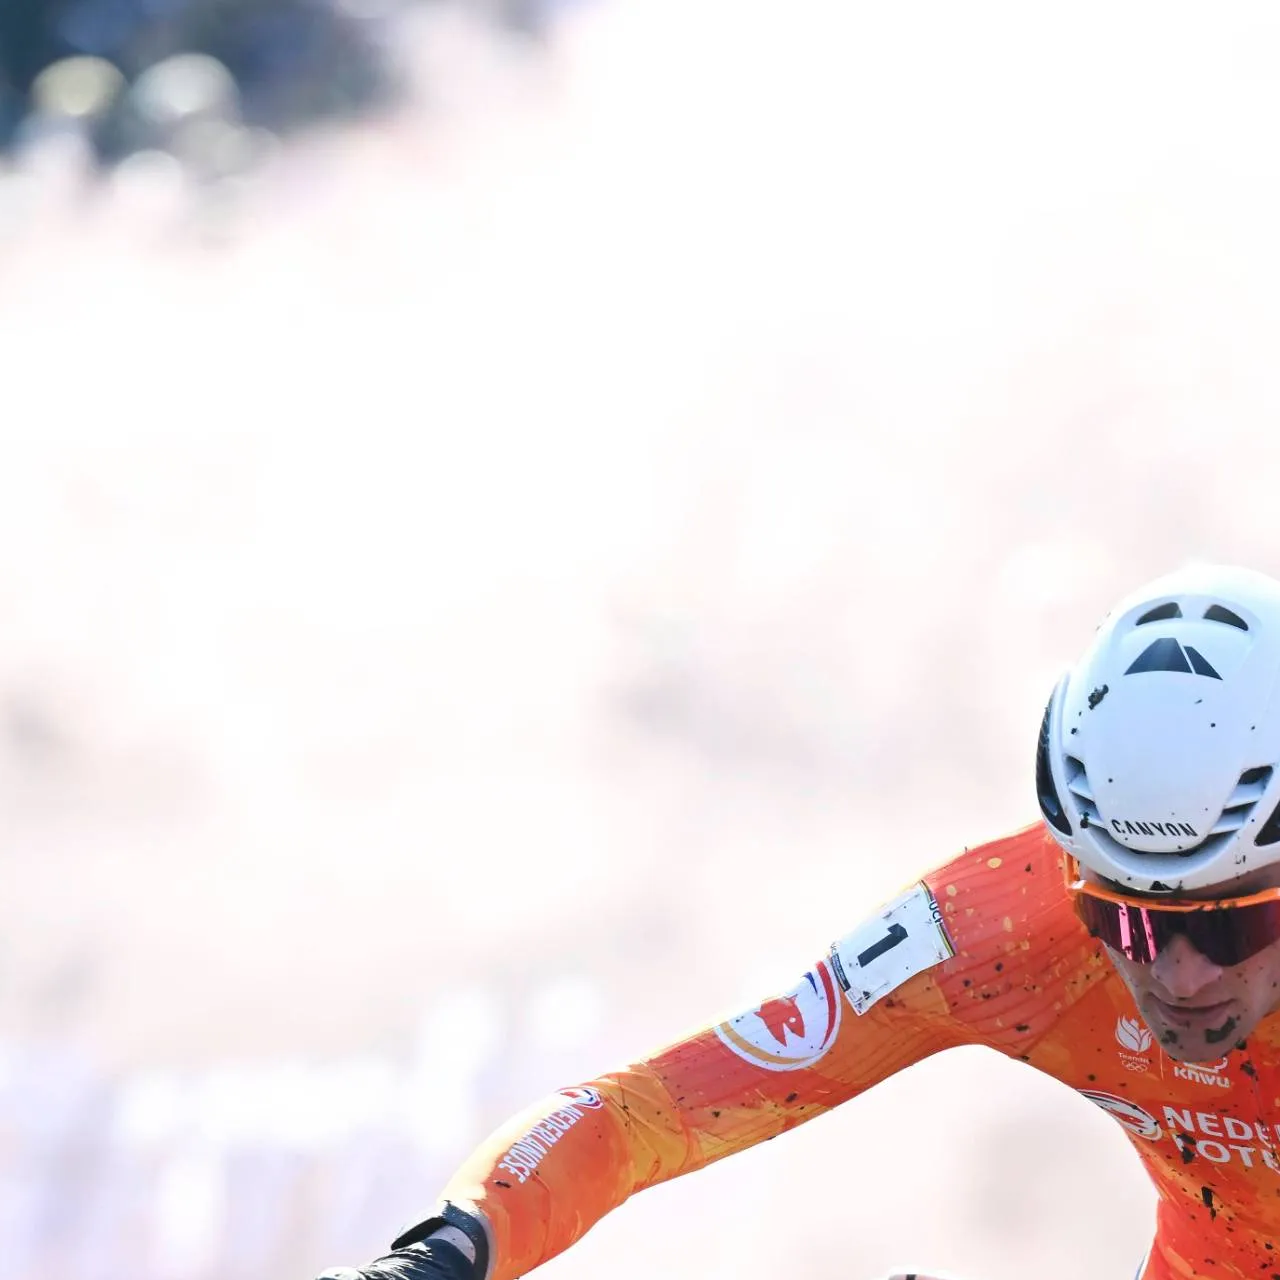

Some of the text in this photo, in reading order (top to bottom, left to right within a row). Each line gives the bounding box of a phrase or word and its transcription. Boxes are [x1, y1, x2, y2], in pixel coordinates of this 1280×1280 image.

[1111, 818, 1198, 837] CANYON
[857, 923, 909, 968] 1
[499, 1104, 585, 1184] NEDERLANDSE
